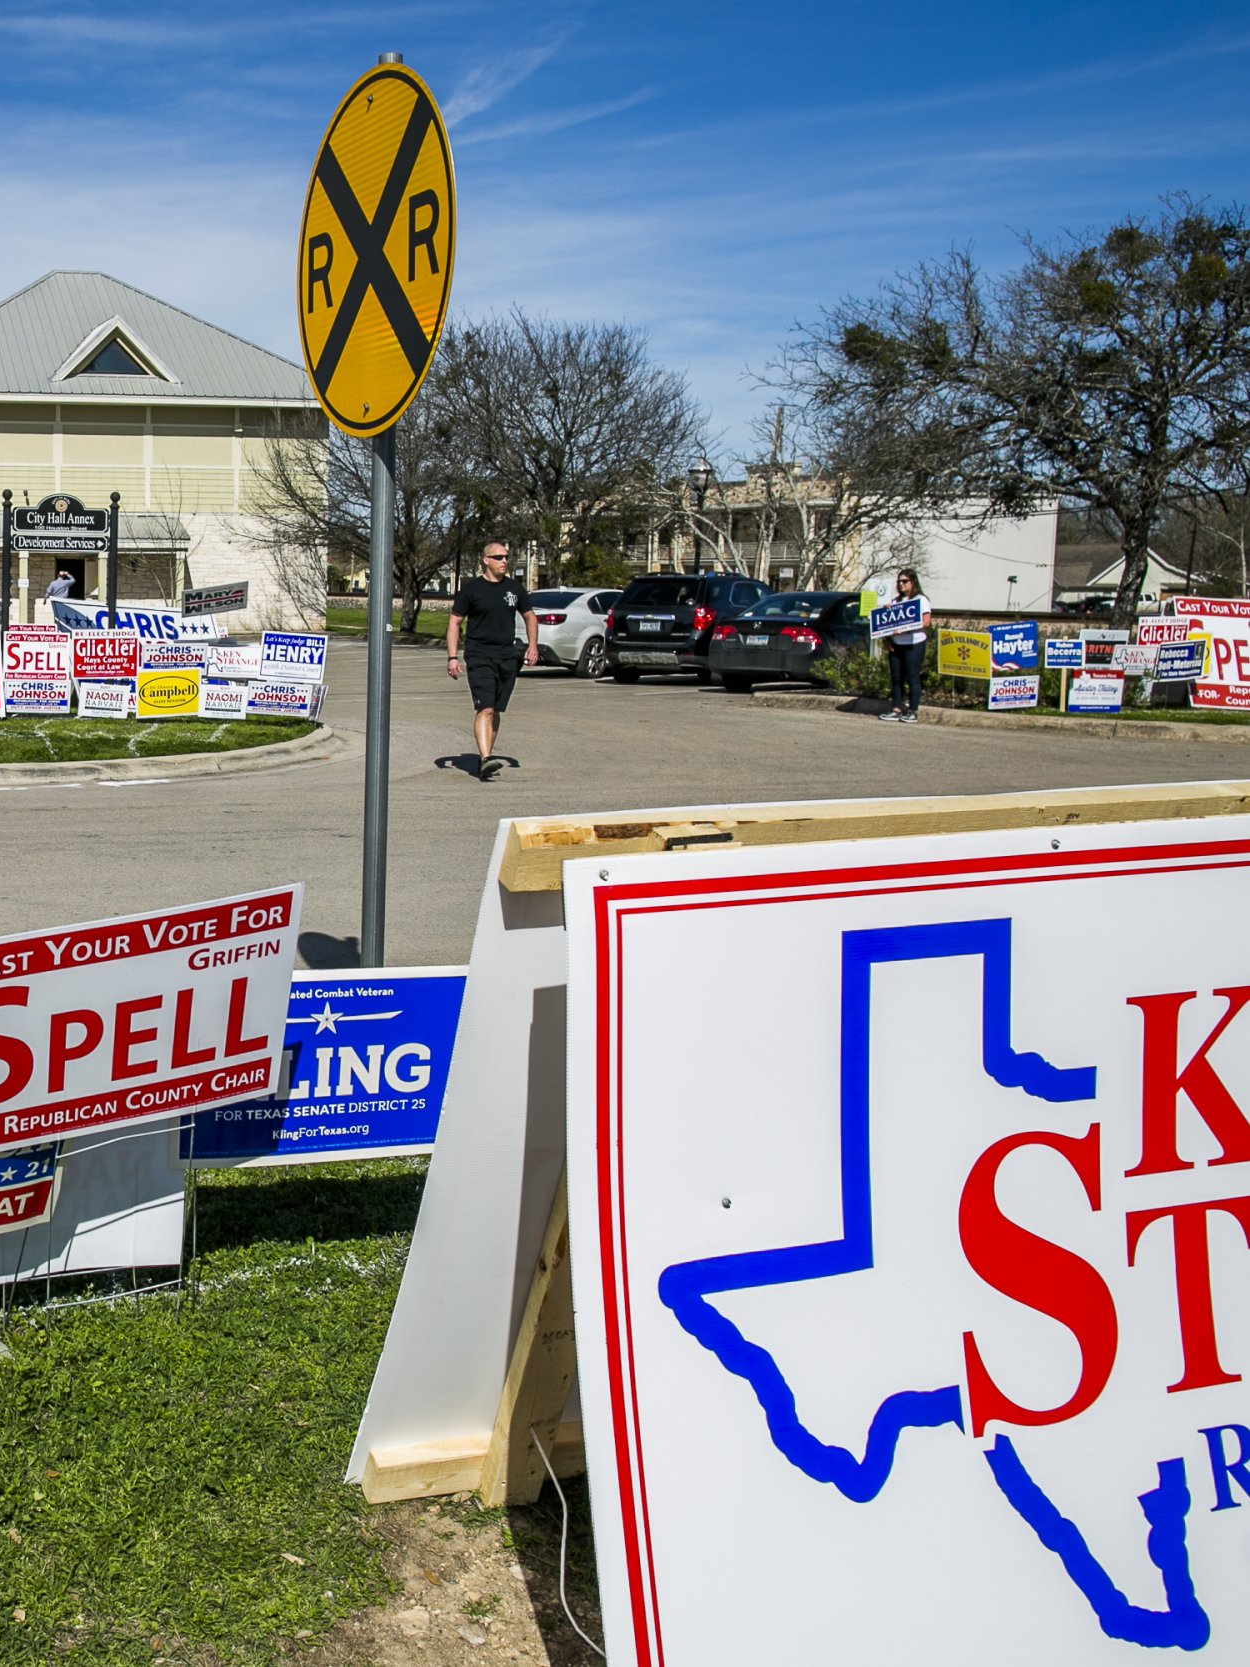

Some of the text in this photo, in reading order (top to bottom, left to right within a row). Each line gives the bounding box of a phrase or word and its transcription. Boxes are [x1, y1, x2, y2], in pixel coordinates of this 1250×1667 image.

[27, 511, 95, 526] City Hall Annex
[18, 536, 95, 549] Development Services
[185, 590, 232, 602] MARY
[185, 597, 244, 614] WILSON
[1177, 601, 1230, 613] CAST YOUR
[876, 605, 916, 625] ISAAC
[1141, 625, 1187, 642] Glickler
[76, 639, 136, 657] Glickler
[306, 638, 324, 647] BILL
[993, 639, 1034, 655] Hayter
[7, 643, 66, 670] SPELL
[159, 646, 192, 654] CHRIS
[262, 643, 324, 664] HENRY
[1048, 647, 1081, 656] Becerra
[102, 656, 128, 664] County
[147, 654, 203, 662] JOHNSON
[21, 682, 55, 690] CHRIS
[263, 685, 296, 694] CHRIS
[1002, 679, 1027, 688] CHRIS
[10, 690, 66, 699] JOHNSON
[86, 691, 124, 702] NAOMI
[141, 684, 195, 699] Campbell
[205, 692, 243, 702] NAOMI
[251, 692, 306, 703] JOHNSON
[994, 686, 1035, 696] JOHNSON
[85, 699, 123, 709] NARVAIZ
[205, 701, 242, 709] NARVAIZ
[44, 933, 130, 967] YOUR
[142, 917, 217, 949] VOTE
[229, 904, 284, 934] FOR
[187, 938, 281, 972] GRIFFIN
[314, 988, 354, 999] Combat
[356, 986, 394, 997] Veteran
[276, 1042, 432, 1100] LING
[3, 1101, 118, 1133] REPUBLICAN
[124, 1081, 204, 1110] COUNTY
[209, 1067, 266, 1092] CHAIR
[215, 1098, 427, 1122] FOR TEXAS SENATE DISTRICT 25
[272, 1124, 370, 1141] KlingForTexas.org
[24, 1159, 50, 1179] 21
